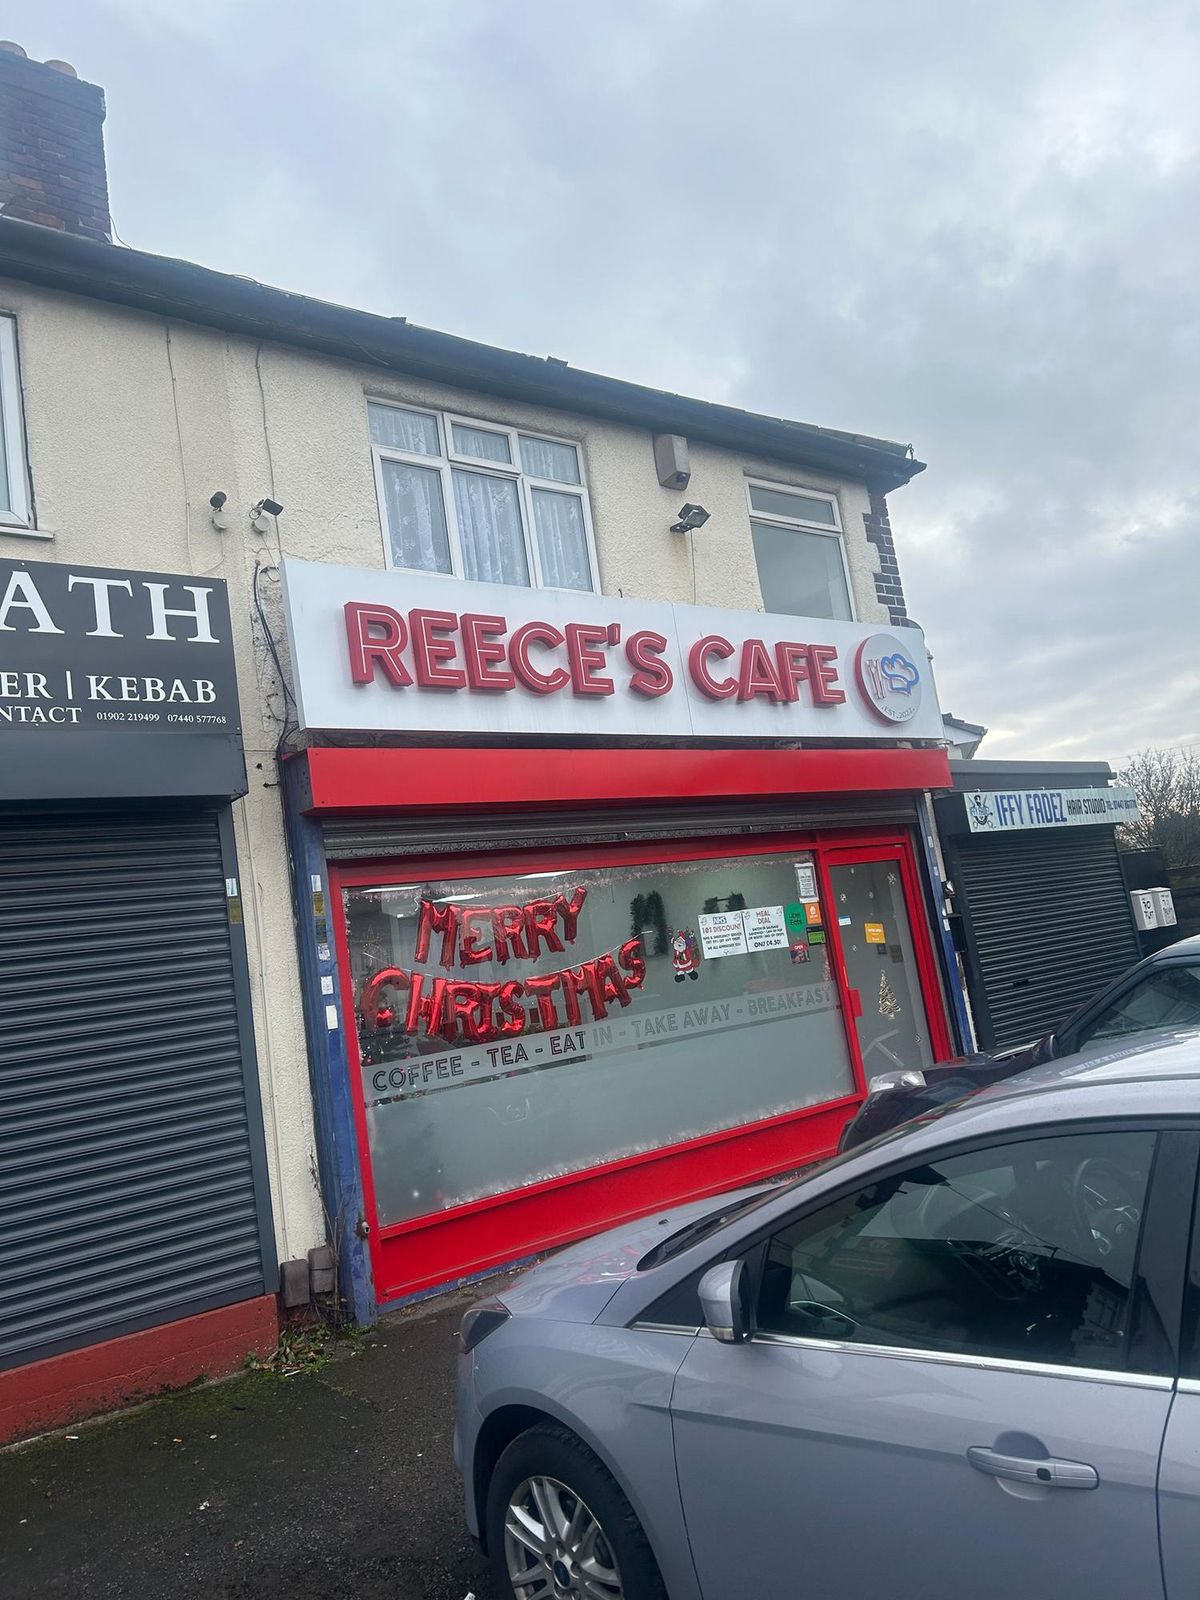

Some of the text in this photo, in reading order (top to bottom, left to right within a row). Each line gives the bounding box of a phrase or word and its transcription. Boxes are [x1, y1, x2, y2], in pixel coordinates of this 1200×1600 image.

[0, 570, 220, 644] ATH
[343, 600, 847, 705] REECE'S CAFE
[0, 671, 217, 704] ER KEBAB
[96, 711, 126, 721] 01902
[127, 712, 161, 722] 219499
[167, 713, 194, 723] 07440
[195, 714, 227, 724] 577768
[995, 793, 1025, 826] IFFY
[1066, 799, 1084, 815] HAIR
[1082, 798, 1107, 814] STUDIO
[414, 886, 588, 969] MERRY
[713, 923, 741, 932] DISCOUNT
[757, 917, 771, 925] DEAL
[360, 940, 647, 1044] CHRISTMAS
[372, 986, 831, 1092] COFFEE TEA EAT IN TAKE AWAY BREAKFAST
